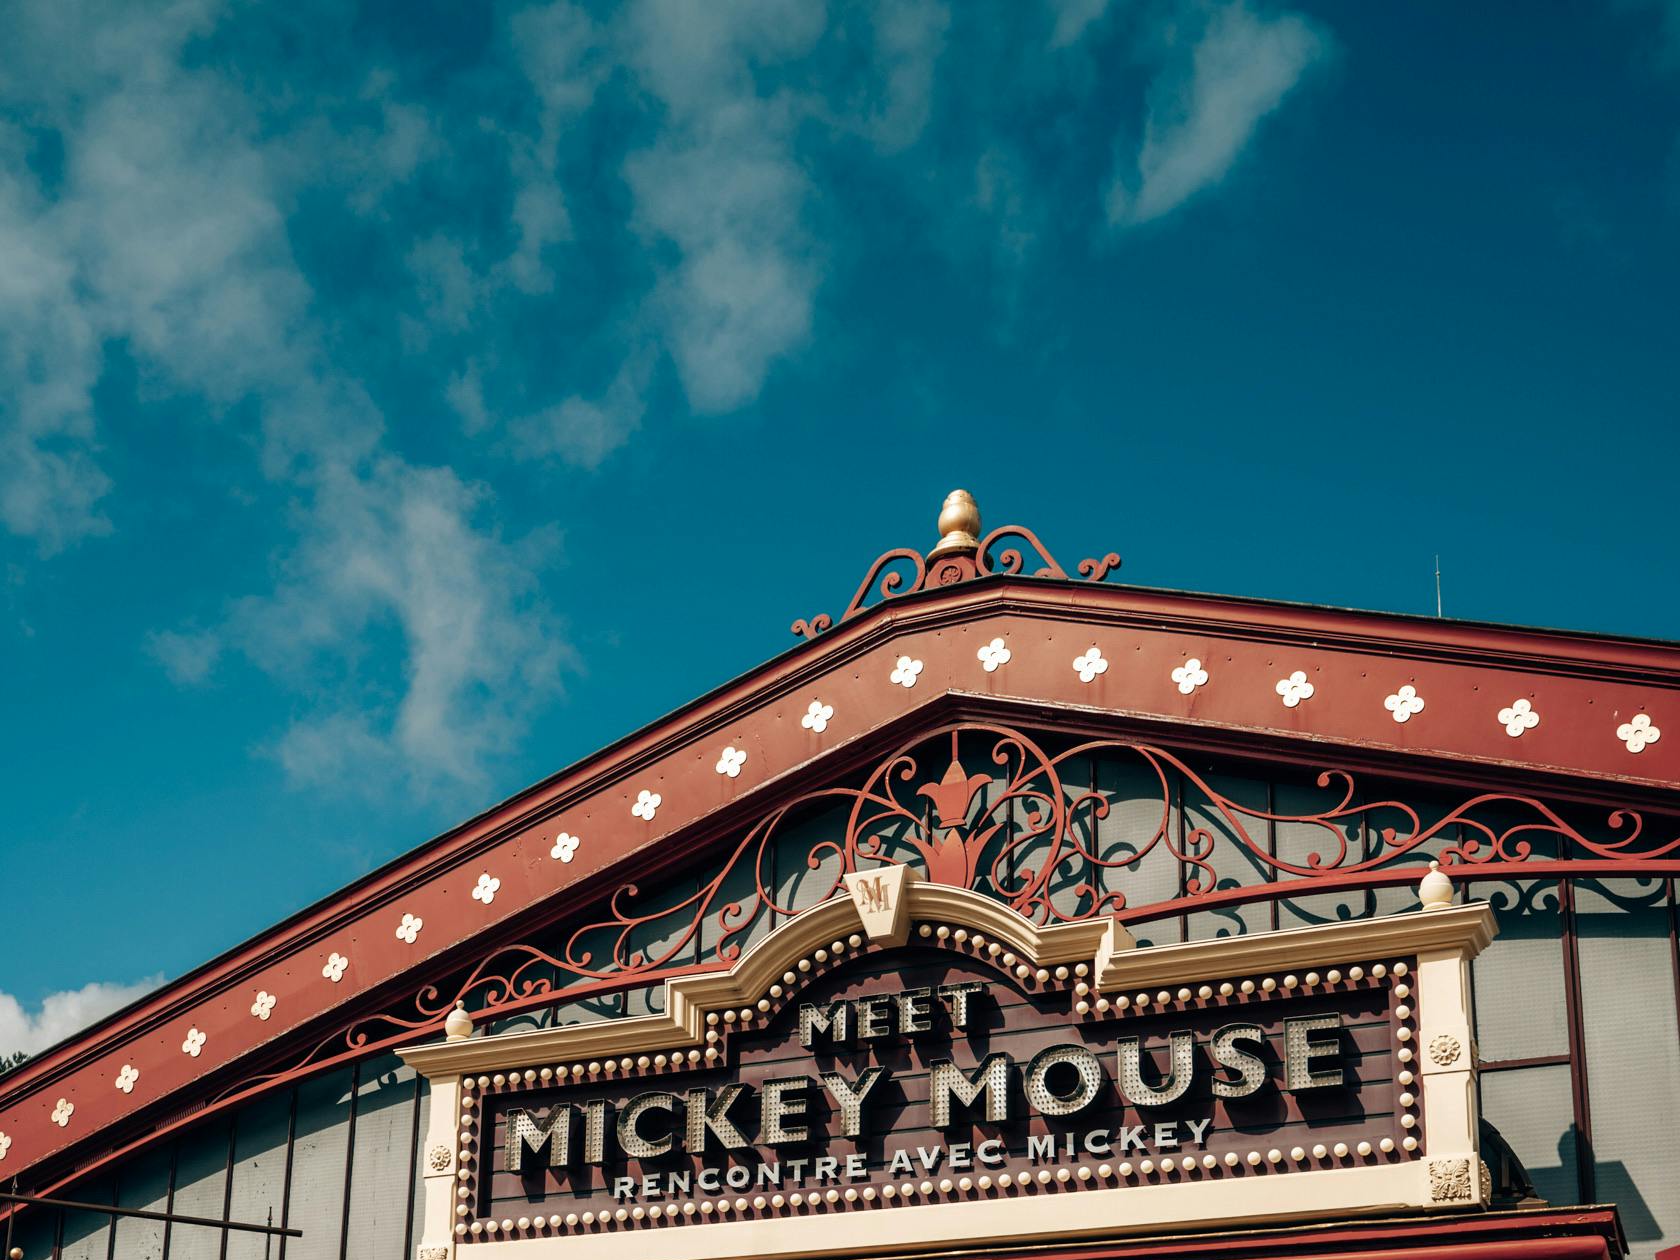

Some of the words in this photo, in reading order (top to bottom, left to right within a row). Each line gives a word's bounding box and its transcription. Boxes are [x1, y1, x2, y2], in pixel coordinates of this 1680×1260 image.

[799, 981, 983, 1046] MEET
[504, 1065, 888, 1172] MICKEY
[929, 1012, 1344, 1128] MOUSE
[613, 1152, 868, 1199] RENCONTRE
[889, 1138, 1003, 1174] AVEC
[1027, 1118, 1211, 1161] MICKEY
